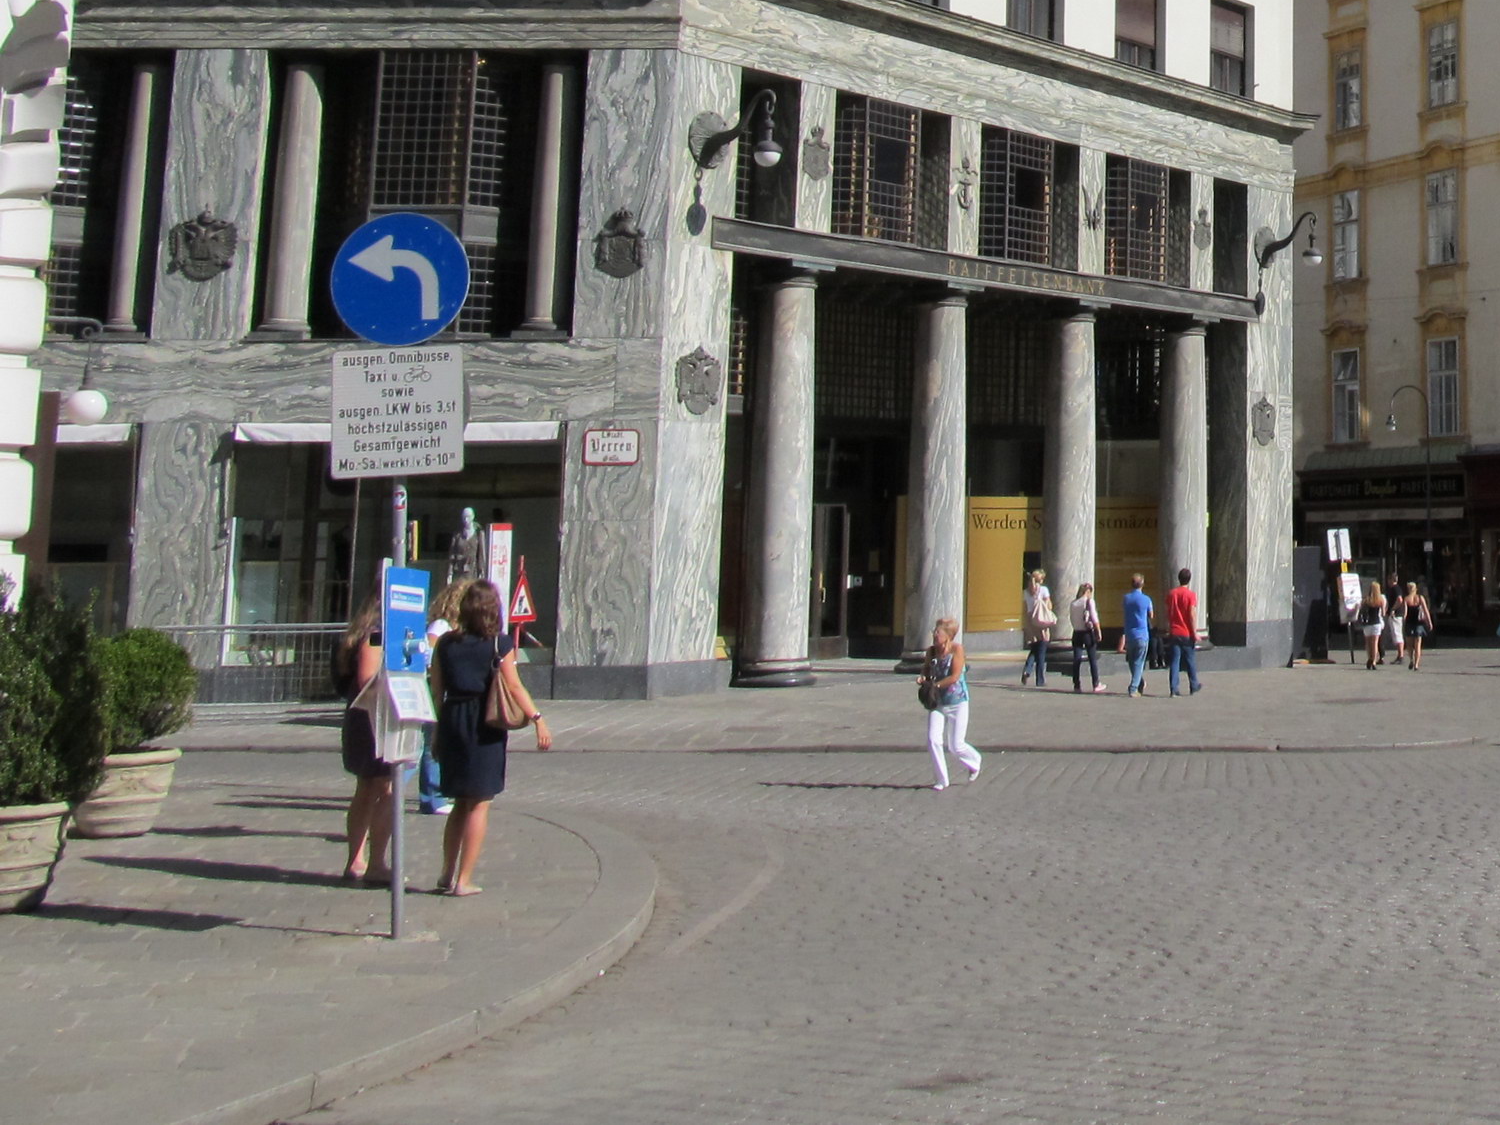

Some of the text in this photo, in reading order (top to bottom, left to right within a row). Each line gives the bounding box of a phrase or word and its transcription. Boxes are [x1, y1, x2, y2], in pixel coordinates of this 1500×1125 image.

[342, 355, 386, 368] ausgen.
[364, 370, 387, 383] Taxi
[381, 385, 414, 398] sowie
[339, 406, 383, 420] ausgen.
[386, 402, 411, 416] LKW
[415, 402, 432, 414] bis
[354, 435, 441, 453] Gesamtgewicht
[972, 513, 1028, 530] Werden
